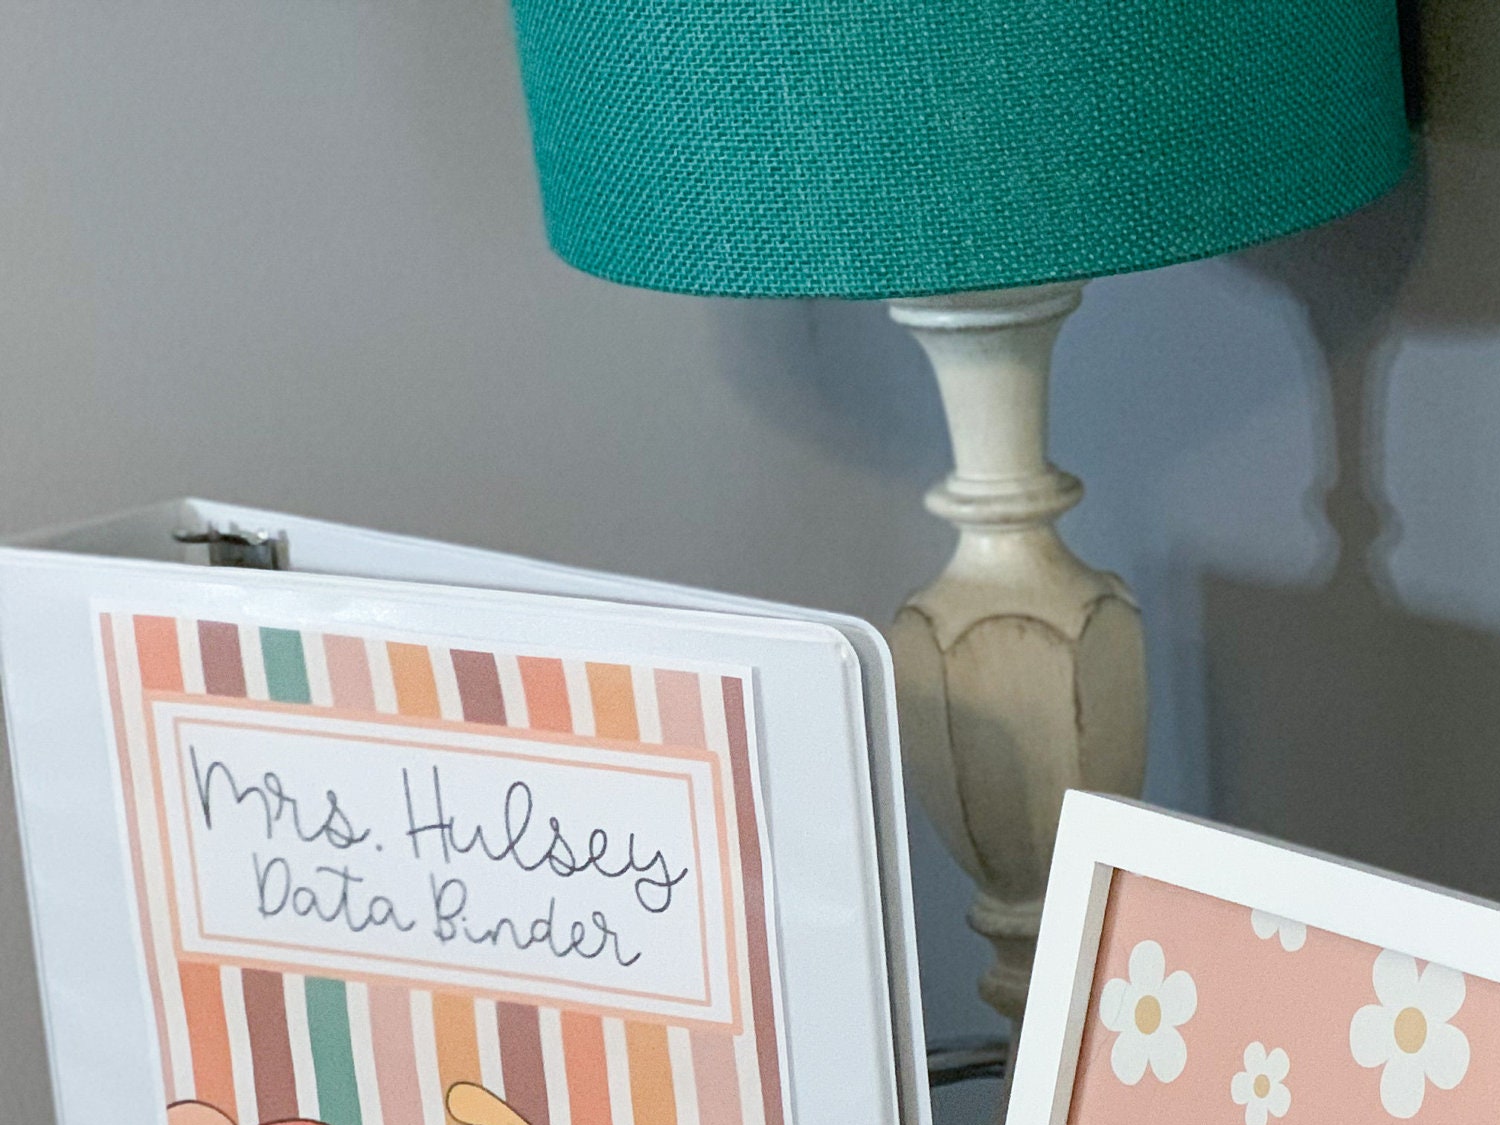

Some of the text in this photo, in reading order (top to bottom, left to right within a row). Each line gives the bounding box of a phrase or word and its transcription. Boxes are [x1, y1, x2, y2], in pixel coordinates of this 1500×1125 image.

[190, 745, 688, 912] Mrs. Hulsey
[253, 852, 641, 967] Data Binder
